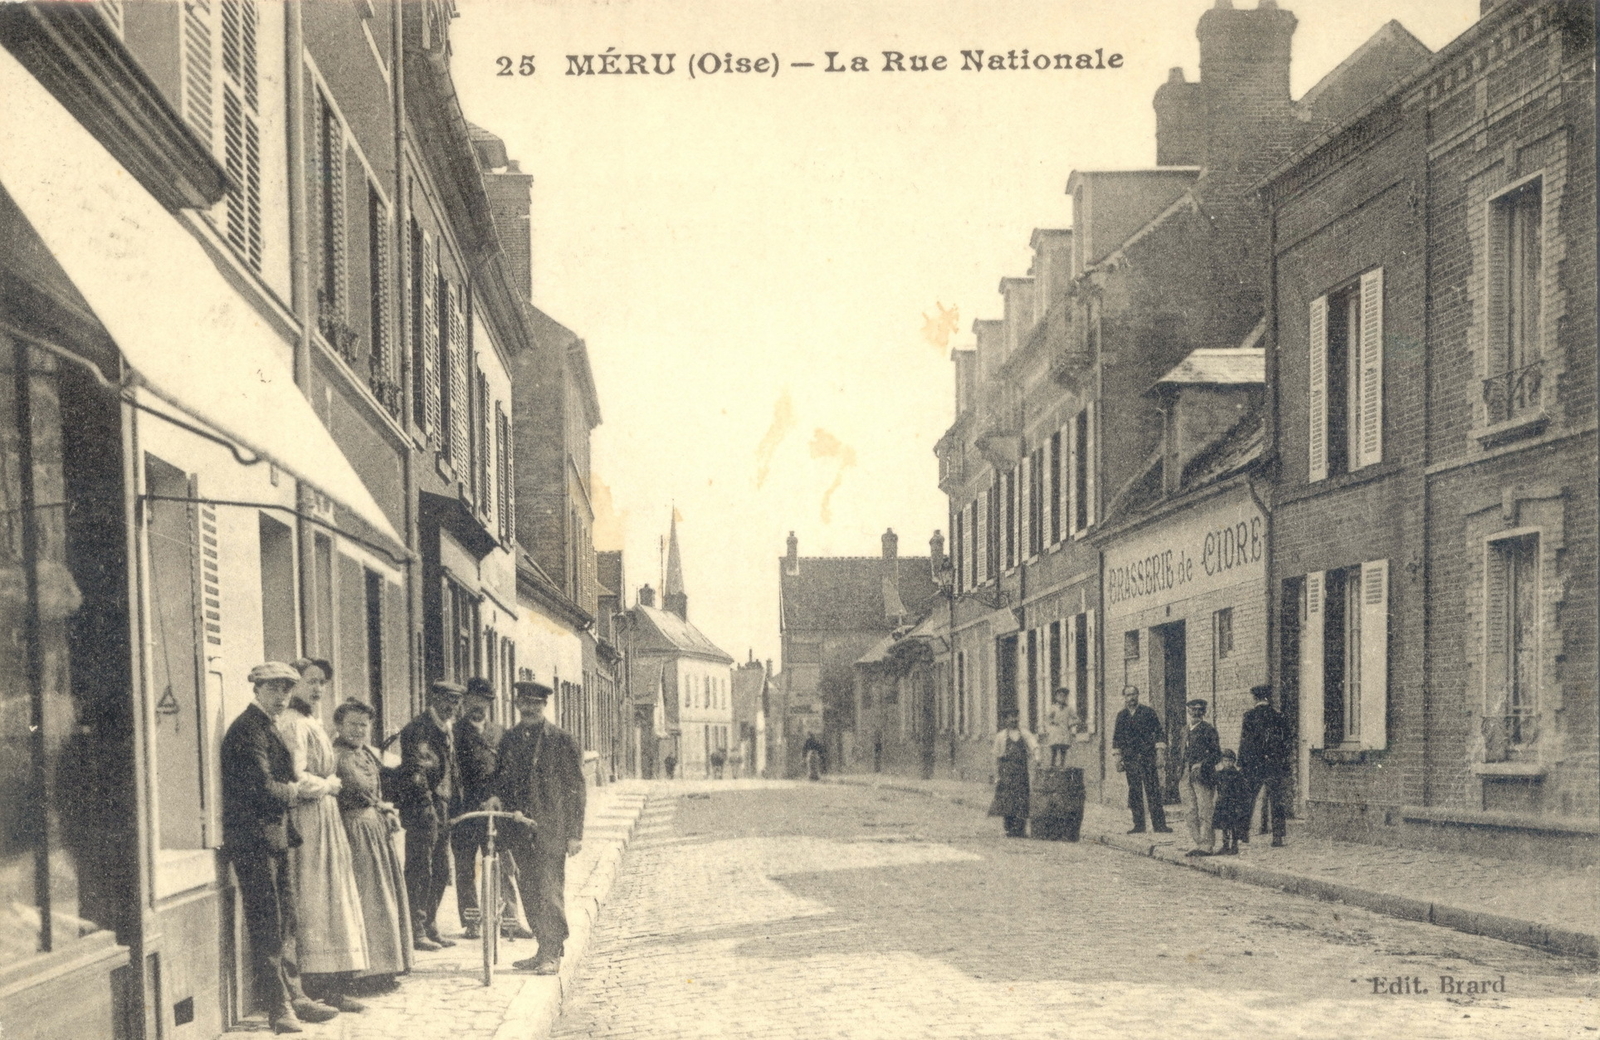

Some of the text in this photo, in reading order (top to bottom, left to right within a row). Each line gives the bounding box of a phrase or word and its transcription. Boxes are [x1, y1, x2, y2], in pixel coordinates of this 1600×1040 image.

[1109, 515, 1262, 605] BRASSERIE de CIDRE
